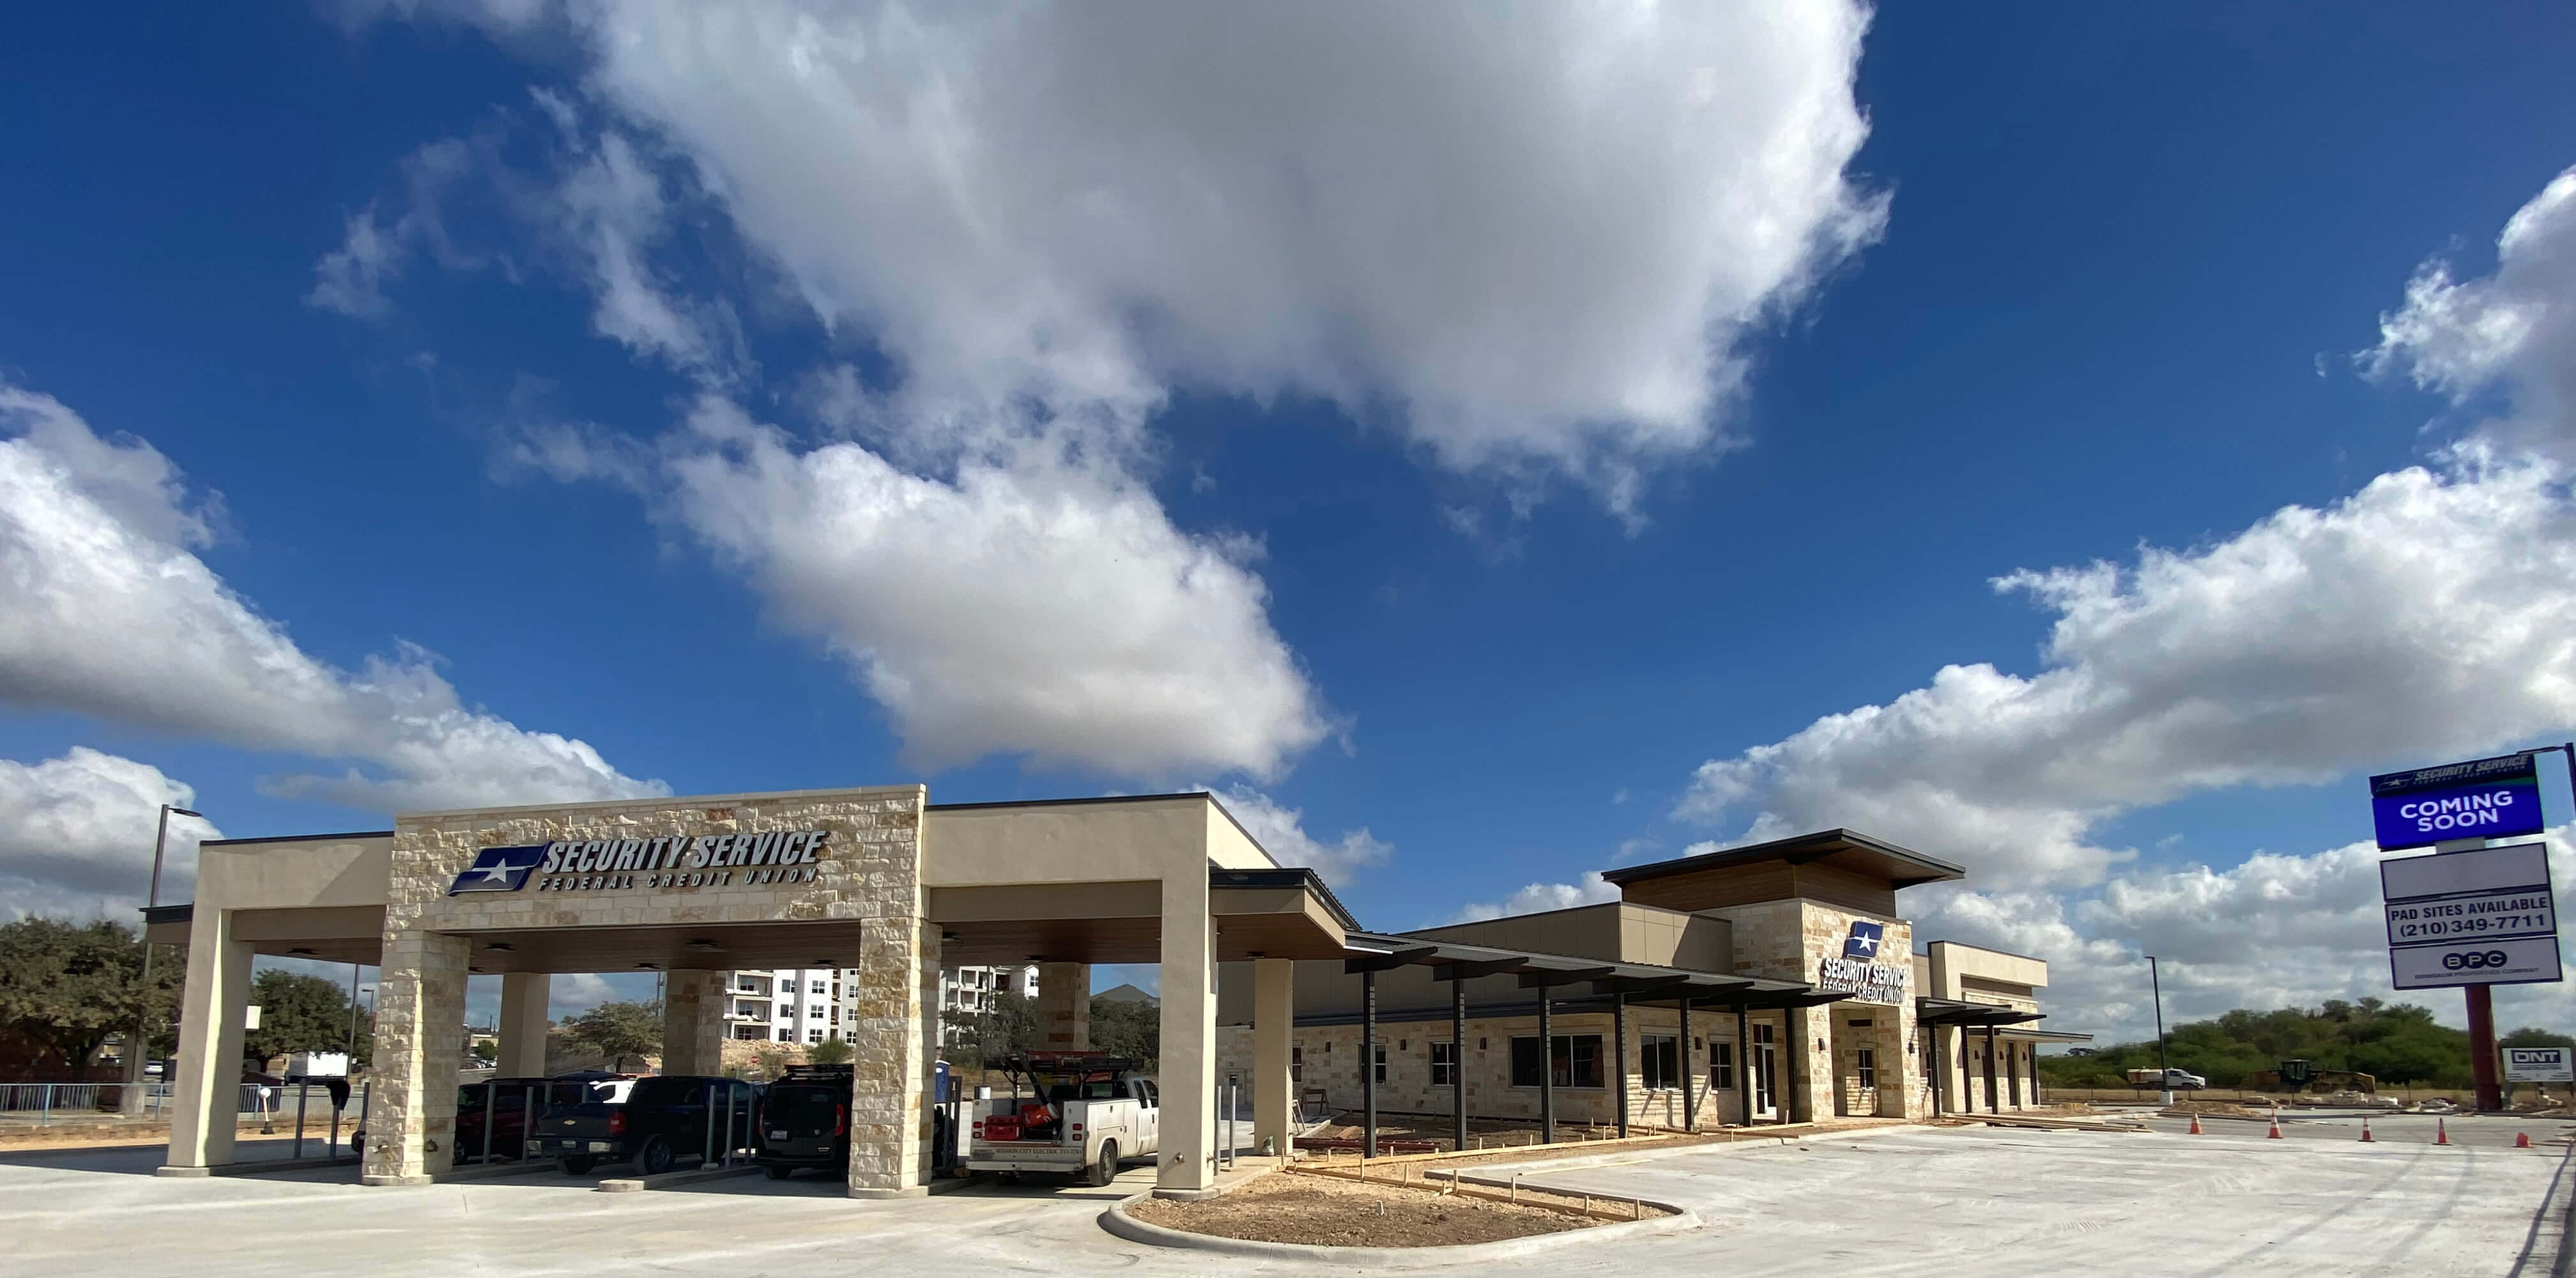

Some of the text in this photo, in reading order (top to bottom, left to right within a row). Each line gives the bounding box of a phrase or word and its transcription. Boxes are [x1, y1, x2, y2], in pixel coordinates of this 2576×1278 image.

[2414, 764, 2474, 781] SECURITY
[2476, 755, 2527, 771] SERVICE
[2400, 790, 2513, 819] COMING
[2418, 808, 2499, 831] SOON
[542, 830, 826, 874] SECURITY SERVICE
[539, 868, 817, 891] FEDERAL CREDIT UNION
[2391, 897, 2548, 921] PAD SITES AVAILABLE
[2400, 914, 2546, 937] (210) 349-7711
[2446, 953, 2504, 967] BPC
[1824, 958, 1907, 987] SECURITY SERVICE
[1858, 986, 1883, 1000] CREDIT
[1884, 988, 1905, 1003] UNION
[2515, 1052, 2559, 1062] DNT
